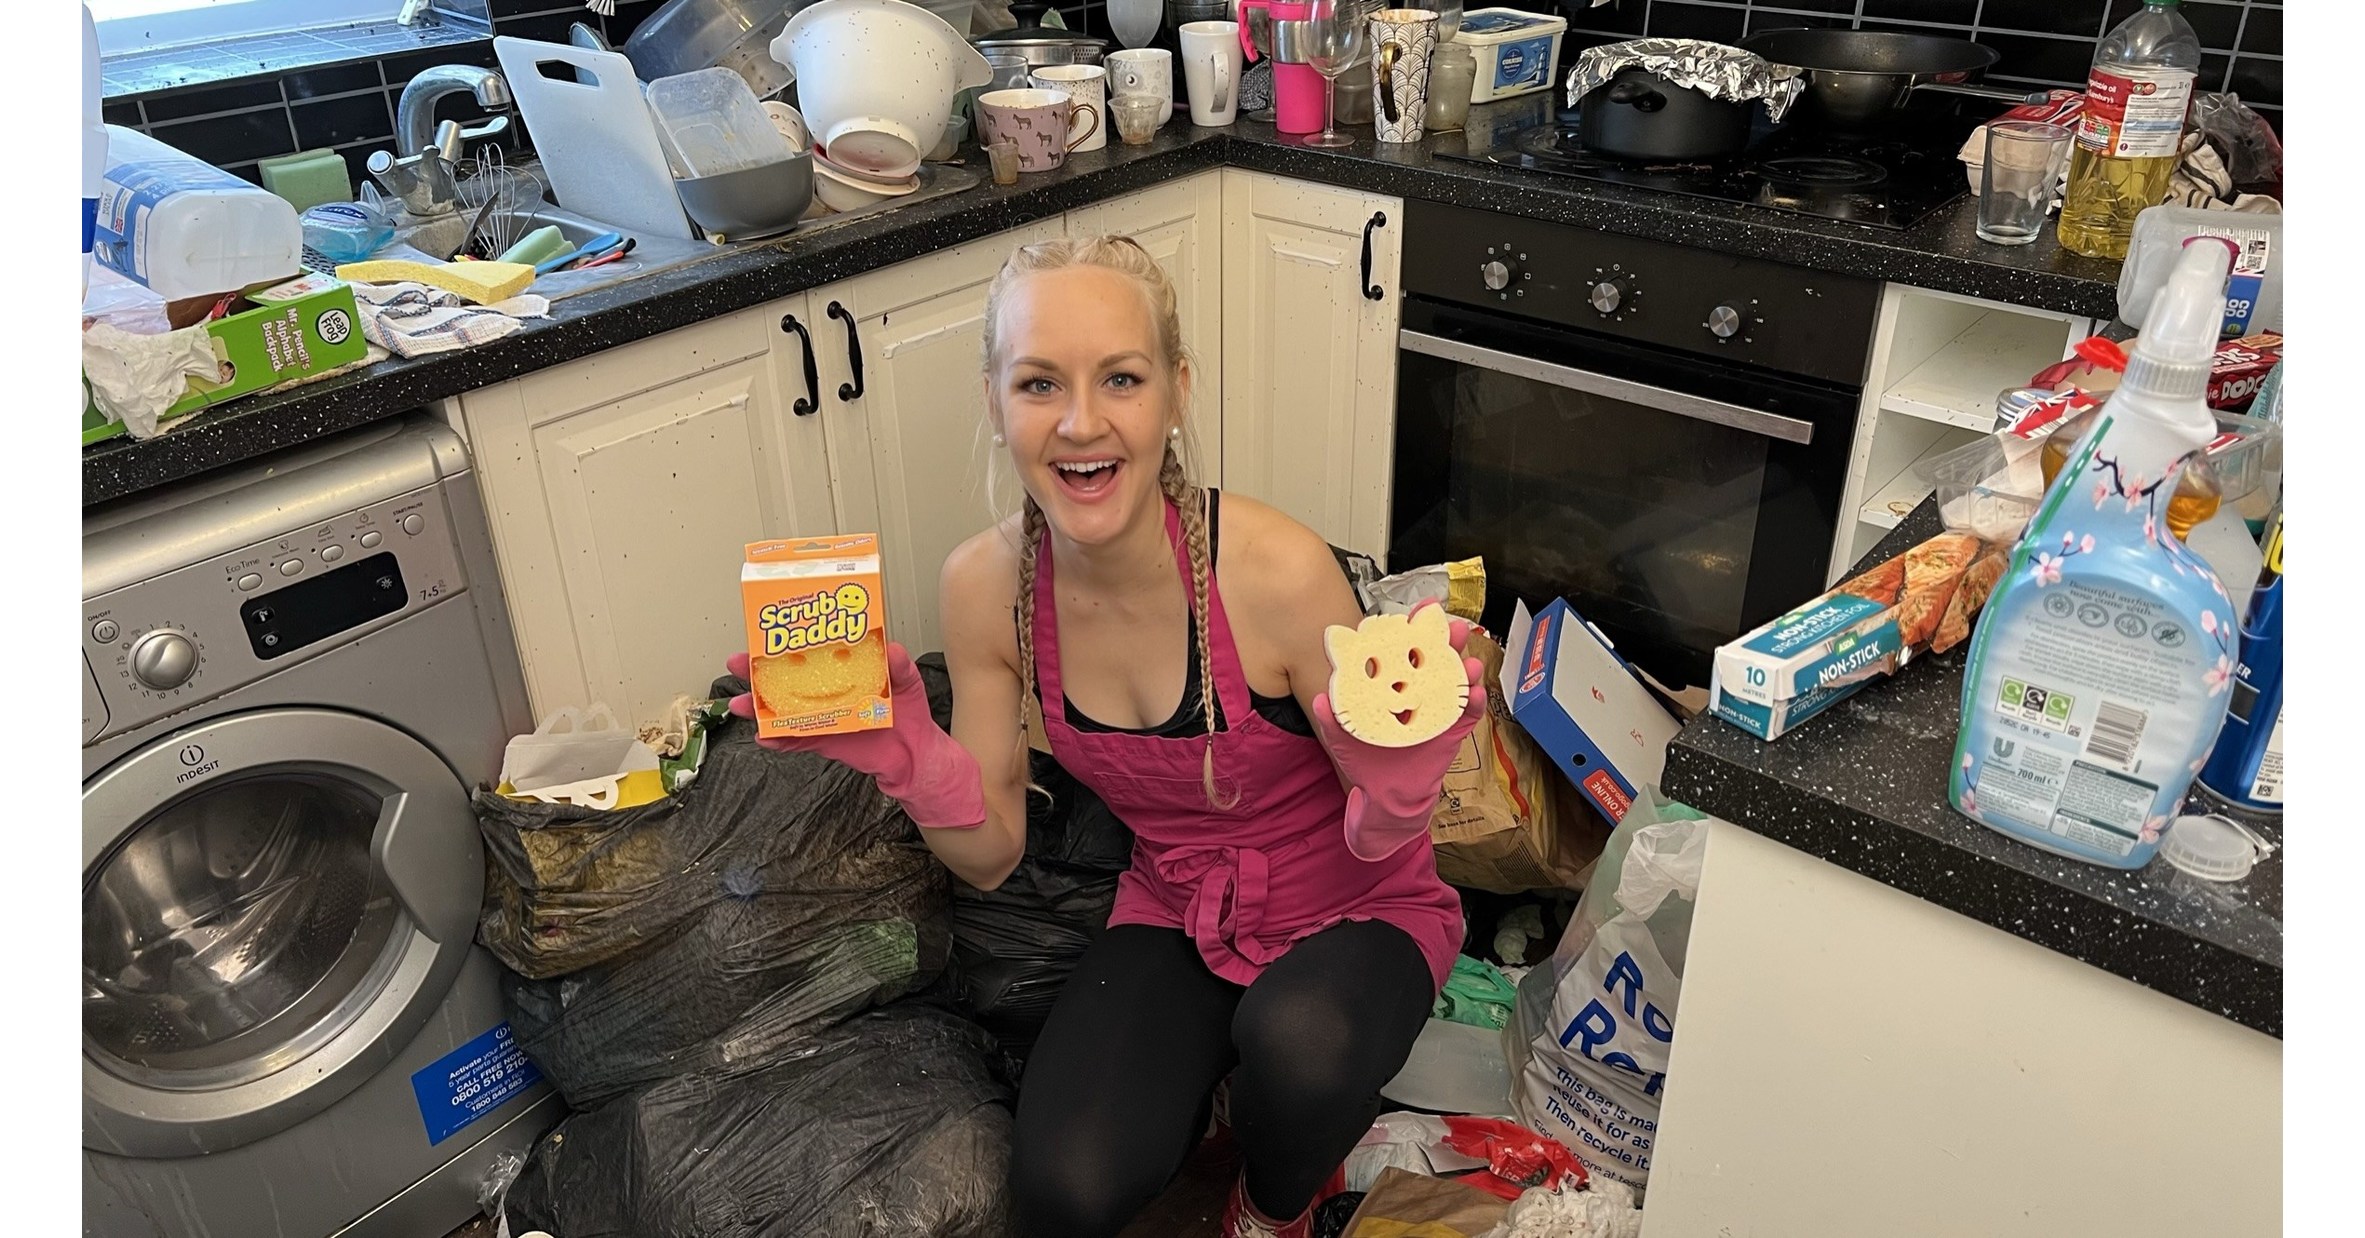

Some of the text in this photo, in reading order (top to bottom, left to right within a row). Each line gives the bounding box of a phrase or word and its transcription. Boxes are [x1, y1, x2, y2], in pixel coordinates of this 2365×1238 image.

[320, 317, 339, 342] Frog
[330, 312, 348, 335] Leap
[262, 322, 284, 372] Backpack
[276, 320, 296, 366] Alphabet
[287, 308, 310, 370] Mr. Pencil's
[760, 591, 837, 630] Scrub
[790, 592, 814, 604] Original
[88, 610, 111, 622] ON/OFF
[1773, 606, 1842, 640] NON-STICK
[766, 608, 867, 656] Daddy
[1818, 640, 1880, 684] NON-STICK
[2236, 662, 2252, 680] ER
[128, 682, 138, 691] 12
[1746, 666, 1766, 687] 10
[142, 690, 150, 698] 11
[157, 692, 166, 700] 10
[1742, 688, 1766, 700] METRES
[818, 709, 852, 721] Scrubber
[1719, 704, 1762, 729] NON-STICK
[2018, 768, 2047, 784] 700 ml
[1591, 782, 1618, 810] ONLINE
[450, 1058, 482, 1080] Activate
[483, 1048, 498, 1060] your
[455, 1072, 470, 1085] year
[472, 1060, 492, 1075] parts
[452, 1085, 480, 1106] 0800
[483, 1070, 504, 1087] 519
[456, 1076, 480, 1093] CALL
[480, 1064, 502, 1080] FREE
[465, 1084, 502, 1109] Customers
[512, 1069, 526, 1081] ROI
[471, 1098, 491, 1112] 1800
[1557, 1066, 1584, 1094] This
[1585, 1087, 1612, 1115] bag
[1614, 1105, 1627, 1120] is
[1546, 1096, 1650, 1172] Then recycle it.
[1593, 1114, 1604, 1129] it
[1606, 1122, 1630, 1141] for
[1632, 1136, 1650, 1150] as
[1534, 1119, 1554, 1139] Find
[1573, 1152, 1602, 1174] more
[1603, 1170, 1616, 1179] at
